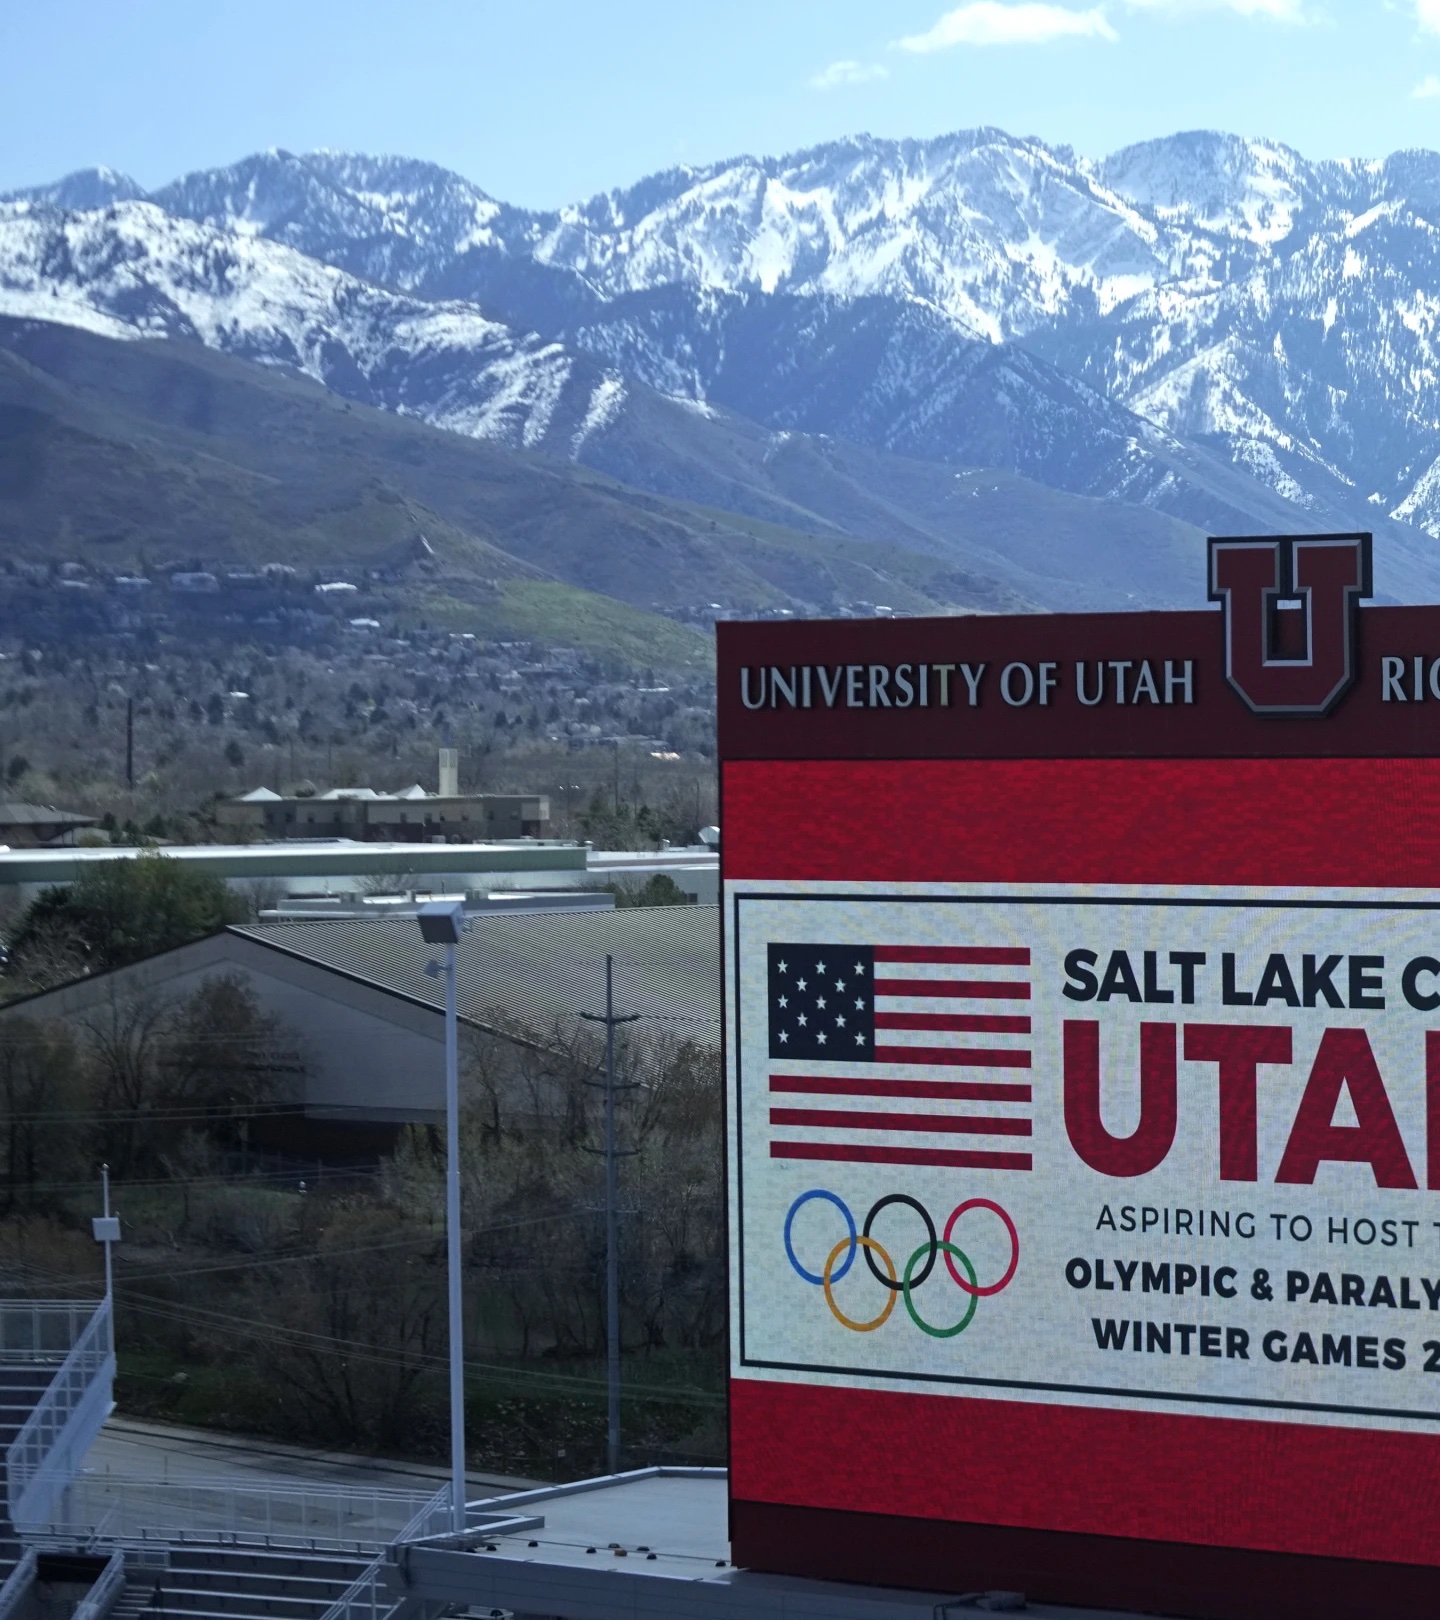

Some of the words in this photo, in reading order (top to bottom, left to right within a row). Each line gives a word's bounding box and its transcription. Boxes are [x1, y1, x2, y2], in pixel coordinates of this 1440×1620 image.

[1207, 532, 1372, 717] U
[741, 663, 986, 709] UNIVERSITY
[1000, 662, 1058, 706] OF
[1075, 660, 1194, 705] UTAH
[1062, 948, 1206, 1004] SALT
[1221, 952, 1386, 1009] LAKE
[1096, 1204, 1256, 1239] ASPIRING
[1270, 1213, 1313, 1242] TO
[1328, 1217, 1419, 1249] HOST
[1065, 1257, 1238, 1300] OLYMPIC
[1250, 1268, 1274, 1302] &
[1092, 1318, 1250, 1360] WINTER
[1262, 1330, 1406, 1370] GAMES
